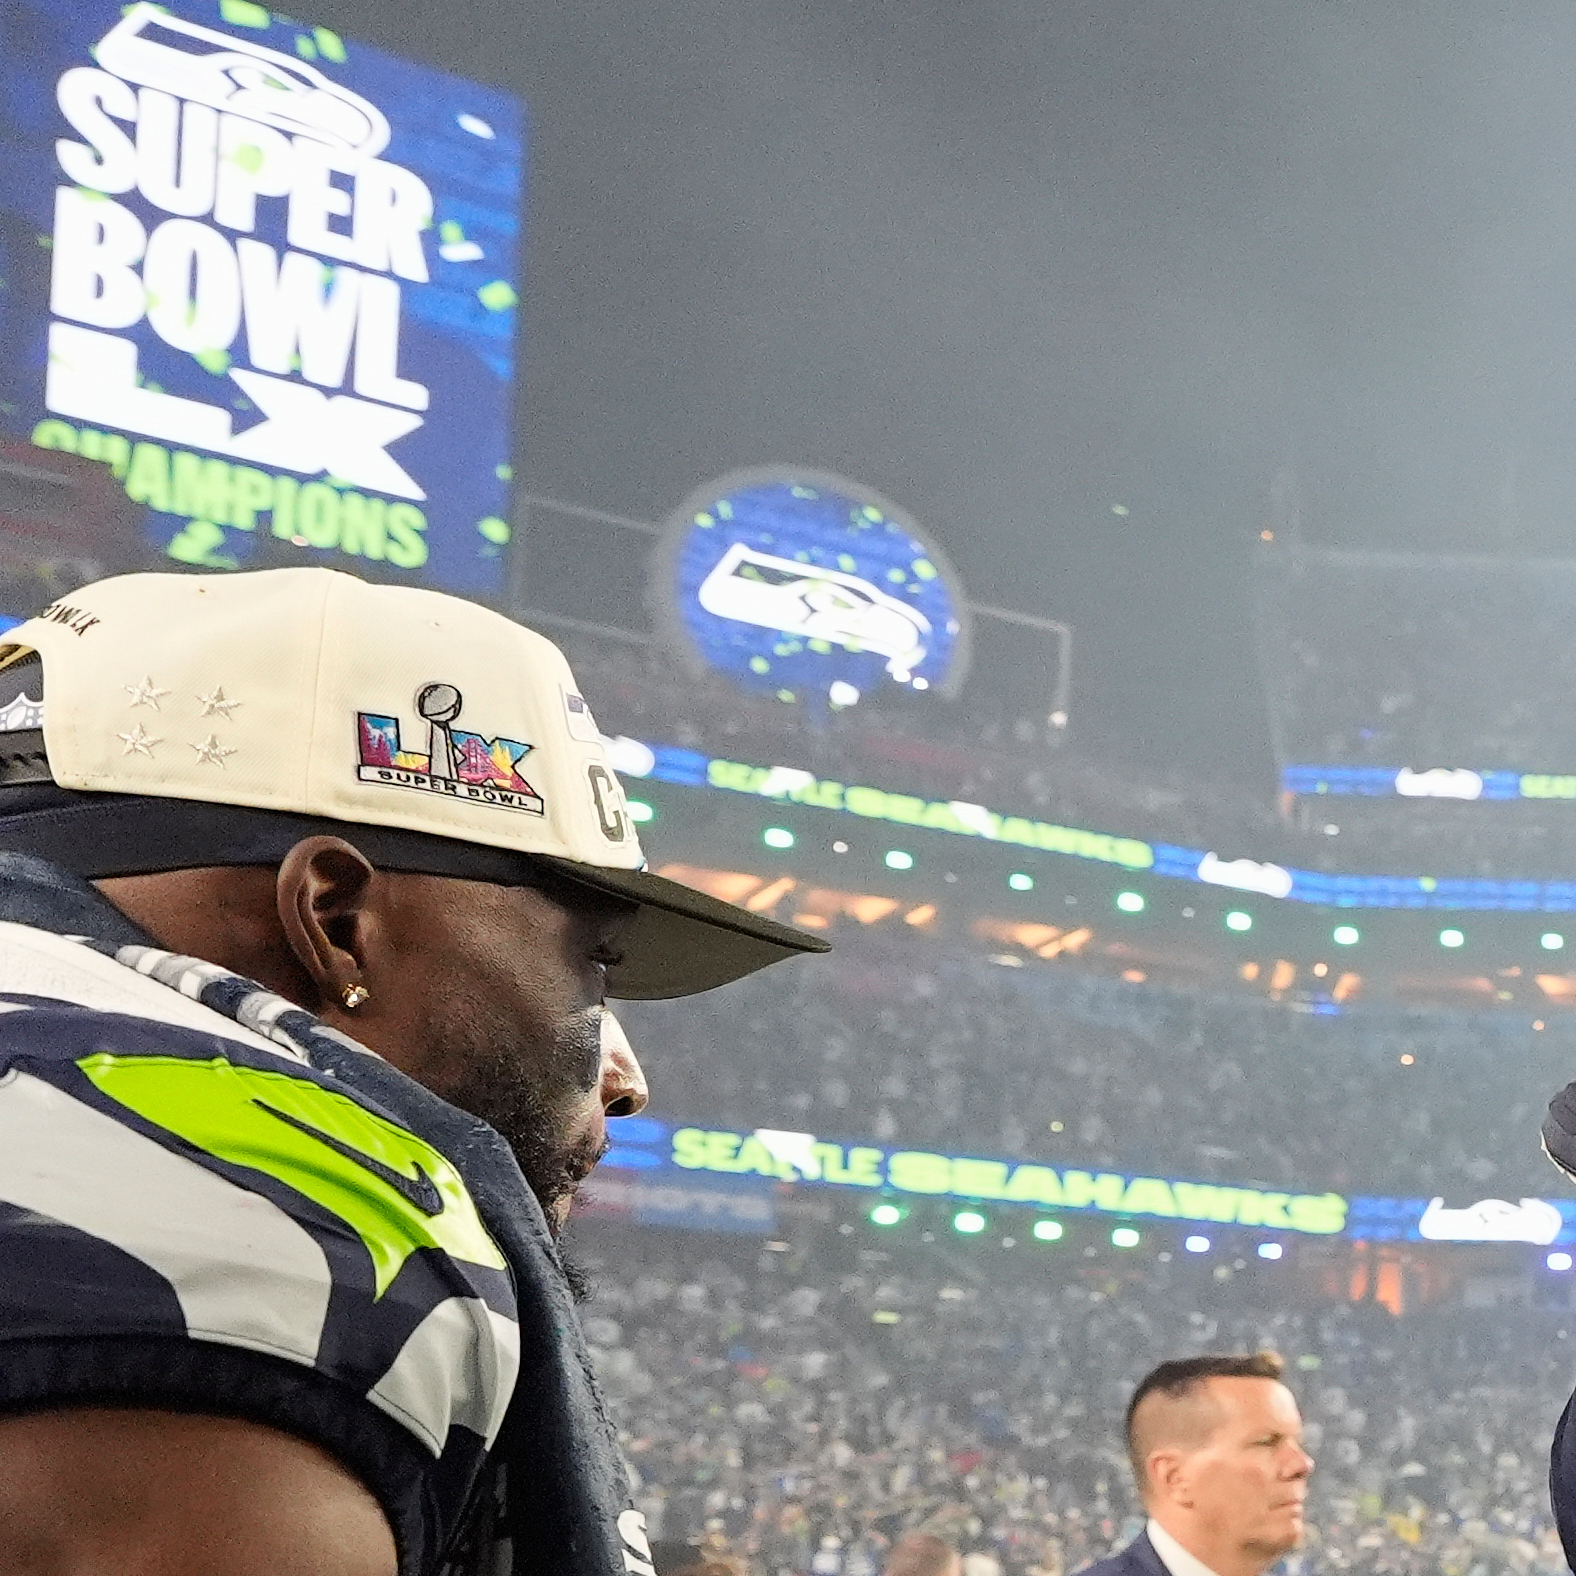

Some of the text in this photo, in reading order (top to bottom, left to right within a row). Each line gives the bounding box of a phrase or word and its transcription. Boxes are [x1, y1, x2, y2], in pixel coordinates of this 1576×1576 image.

[55, 66, 434, 284] SUPER
[49, 184, 430, 411] BOWL
[45, 321, 428, 501] LX
[377, 769, 528, 808] SUPER BOWL
[707, 759, 845, 811] SEALE
[887, 1151, 1349, 1234] SEAHAWKS
